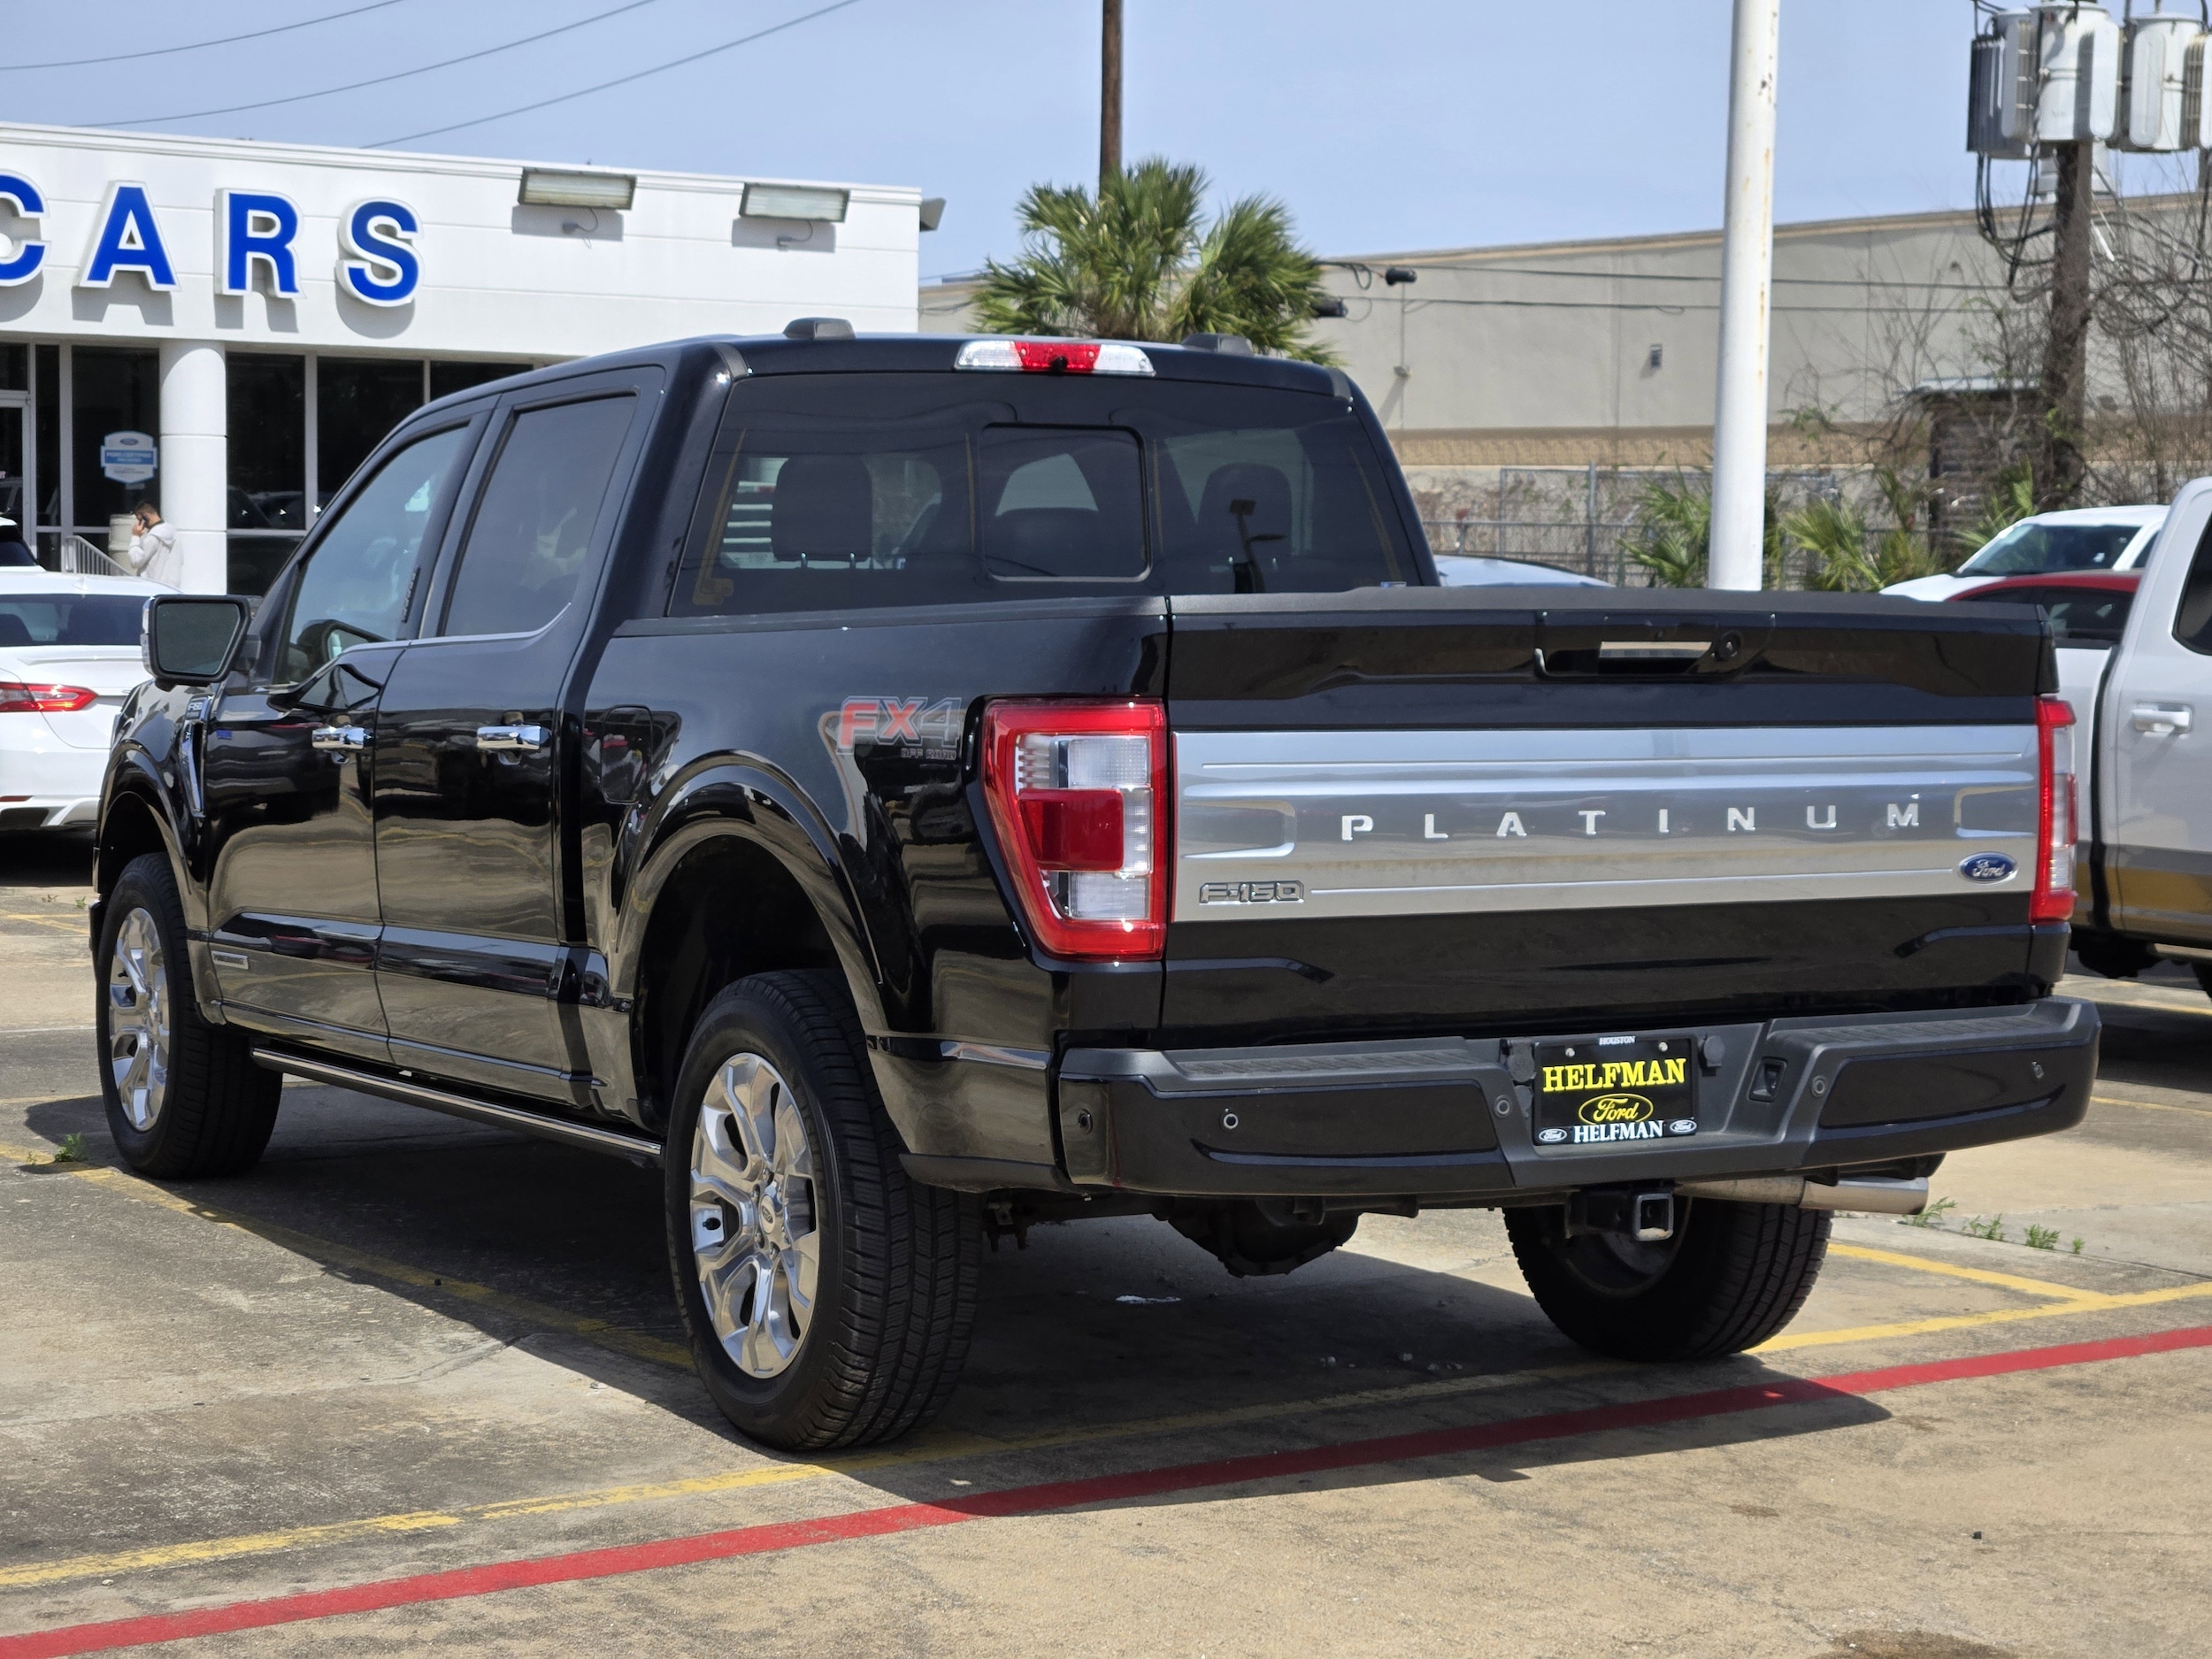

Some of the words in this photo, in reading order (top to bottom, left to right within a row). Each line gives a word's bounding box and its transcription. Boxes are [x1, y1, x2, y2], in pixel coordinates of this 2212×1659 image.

[836, 695, 962, 756] FX4
[901, 747, 924, 759] OFF
[926, 749, 957, 761] ROAD
[1341, 803, 1920, 841] PLATINUM
[1199, 879, 1305, 906] F-150
[1599, 1035, 1636, 1046] HOUSTON
[1542, 1058, 1686, 1093] HELFMAN
[1594, 1098, 1640, 1122] Ford
[1573, 1120, 1664, 1143] HELFMAN
